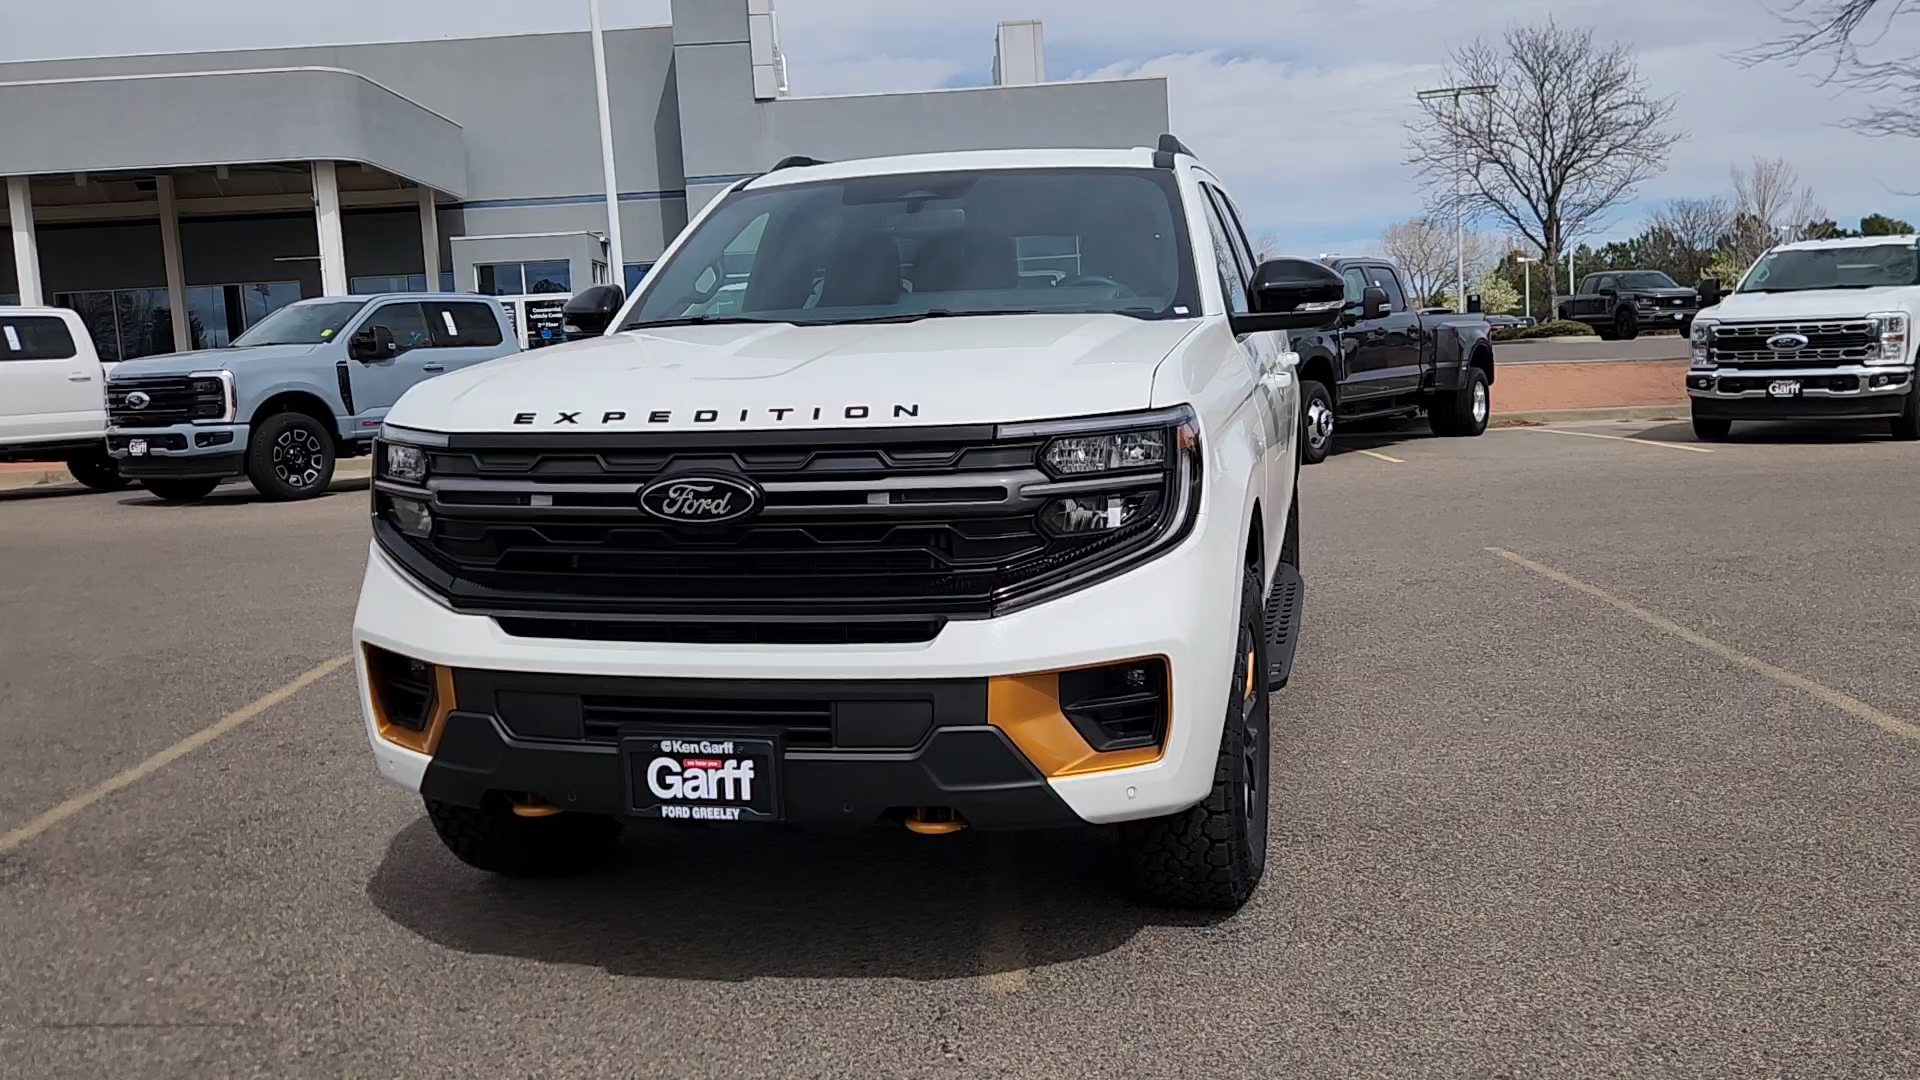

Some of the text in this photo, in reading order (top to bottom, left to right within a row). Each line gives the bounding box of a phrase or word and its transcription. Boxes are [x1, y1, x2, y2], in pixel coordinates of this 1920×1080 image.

[1769, 382, 1800, 394] Garff
[513, 404, 919, 425] EXPEDITION
[662, 484, 732, 515] Ford
[672, 740, 734, 755] Ken Garff
[647, 756, 755, 801] Garff
[661, 805, 740, 820] FORD GREELEY
